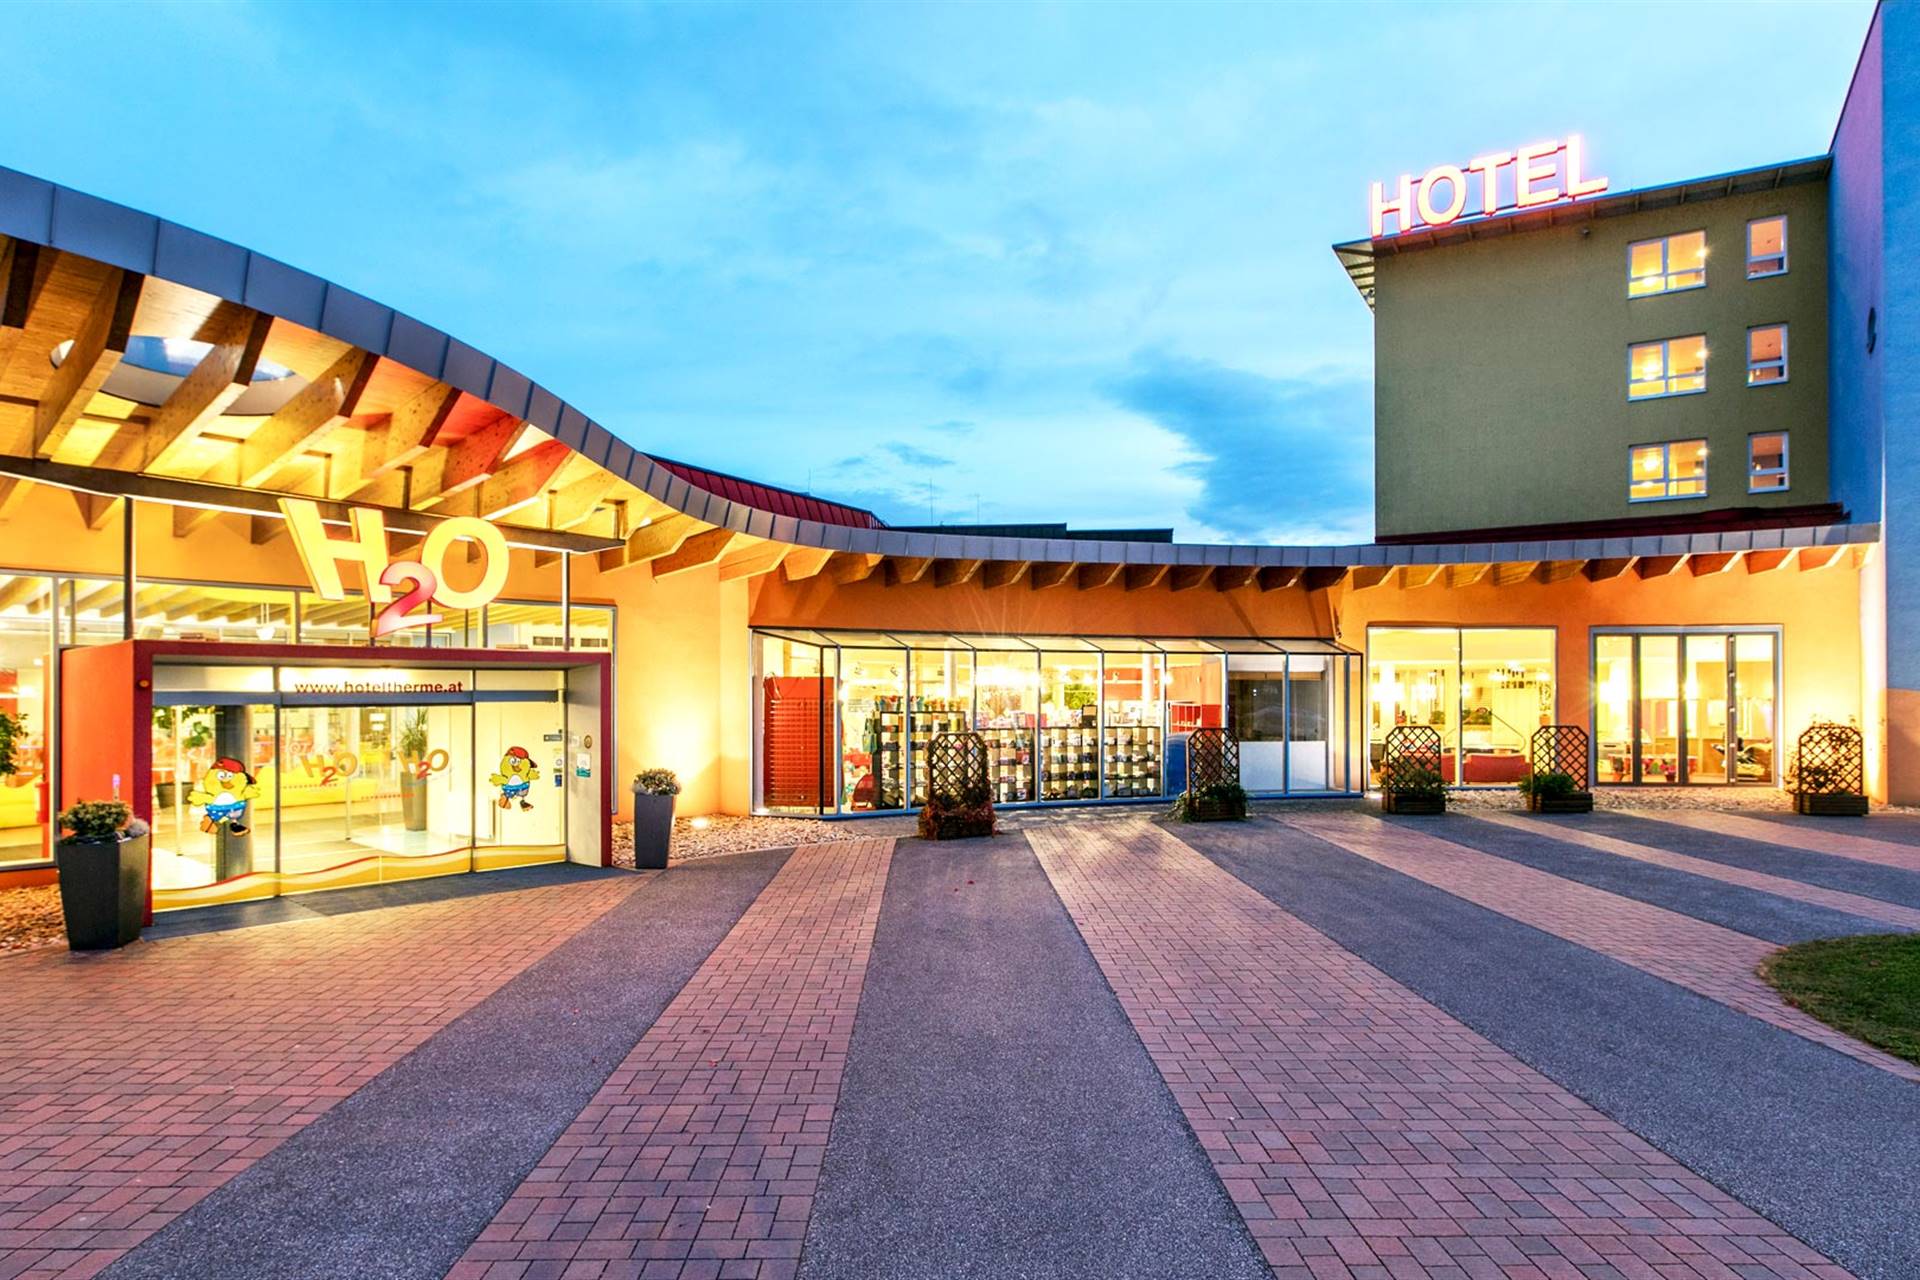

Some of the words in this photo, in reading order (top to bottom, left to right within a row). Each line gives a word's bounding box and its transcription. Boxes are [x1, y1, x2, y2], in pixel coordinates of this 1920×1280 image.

[1371, 134, 1609, 239] HOTEL
[277, 498, 510, 637] H2O
[294, 681, 464, 694] www.hoteltherme.at
[300, 751, 358, 787] H2O
[398, 748, 450, 781] H2O
